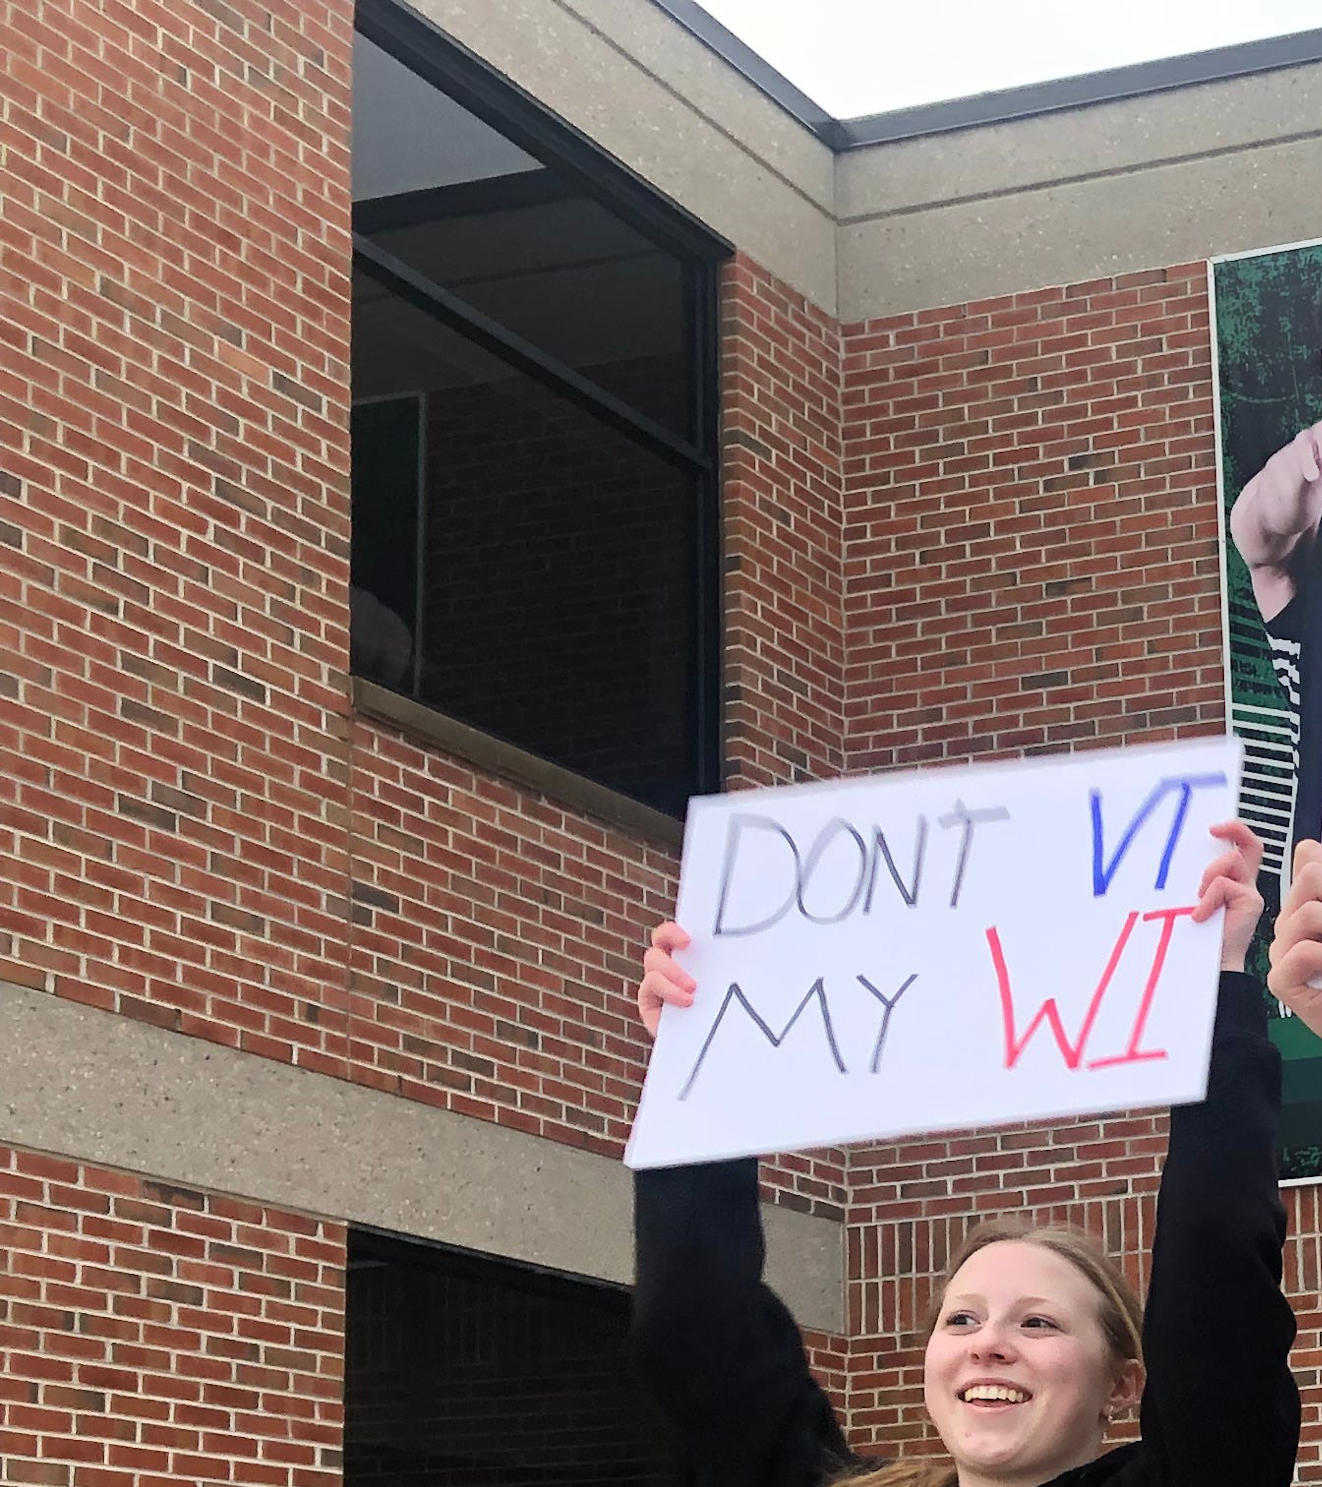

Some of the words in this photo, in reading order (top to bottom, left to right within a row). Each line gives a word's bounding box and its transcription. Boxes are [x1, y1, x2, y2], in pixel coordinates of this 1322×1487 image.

[713, 798, 1010, 938] DONT
[1089, 770, 1227, 896] VT
[677, 972, 918, 1101] MY
[985, 904, 1200, 1070] WI
